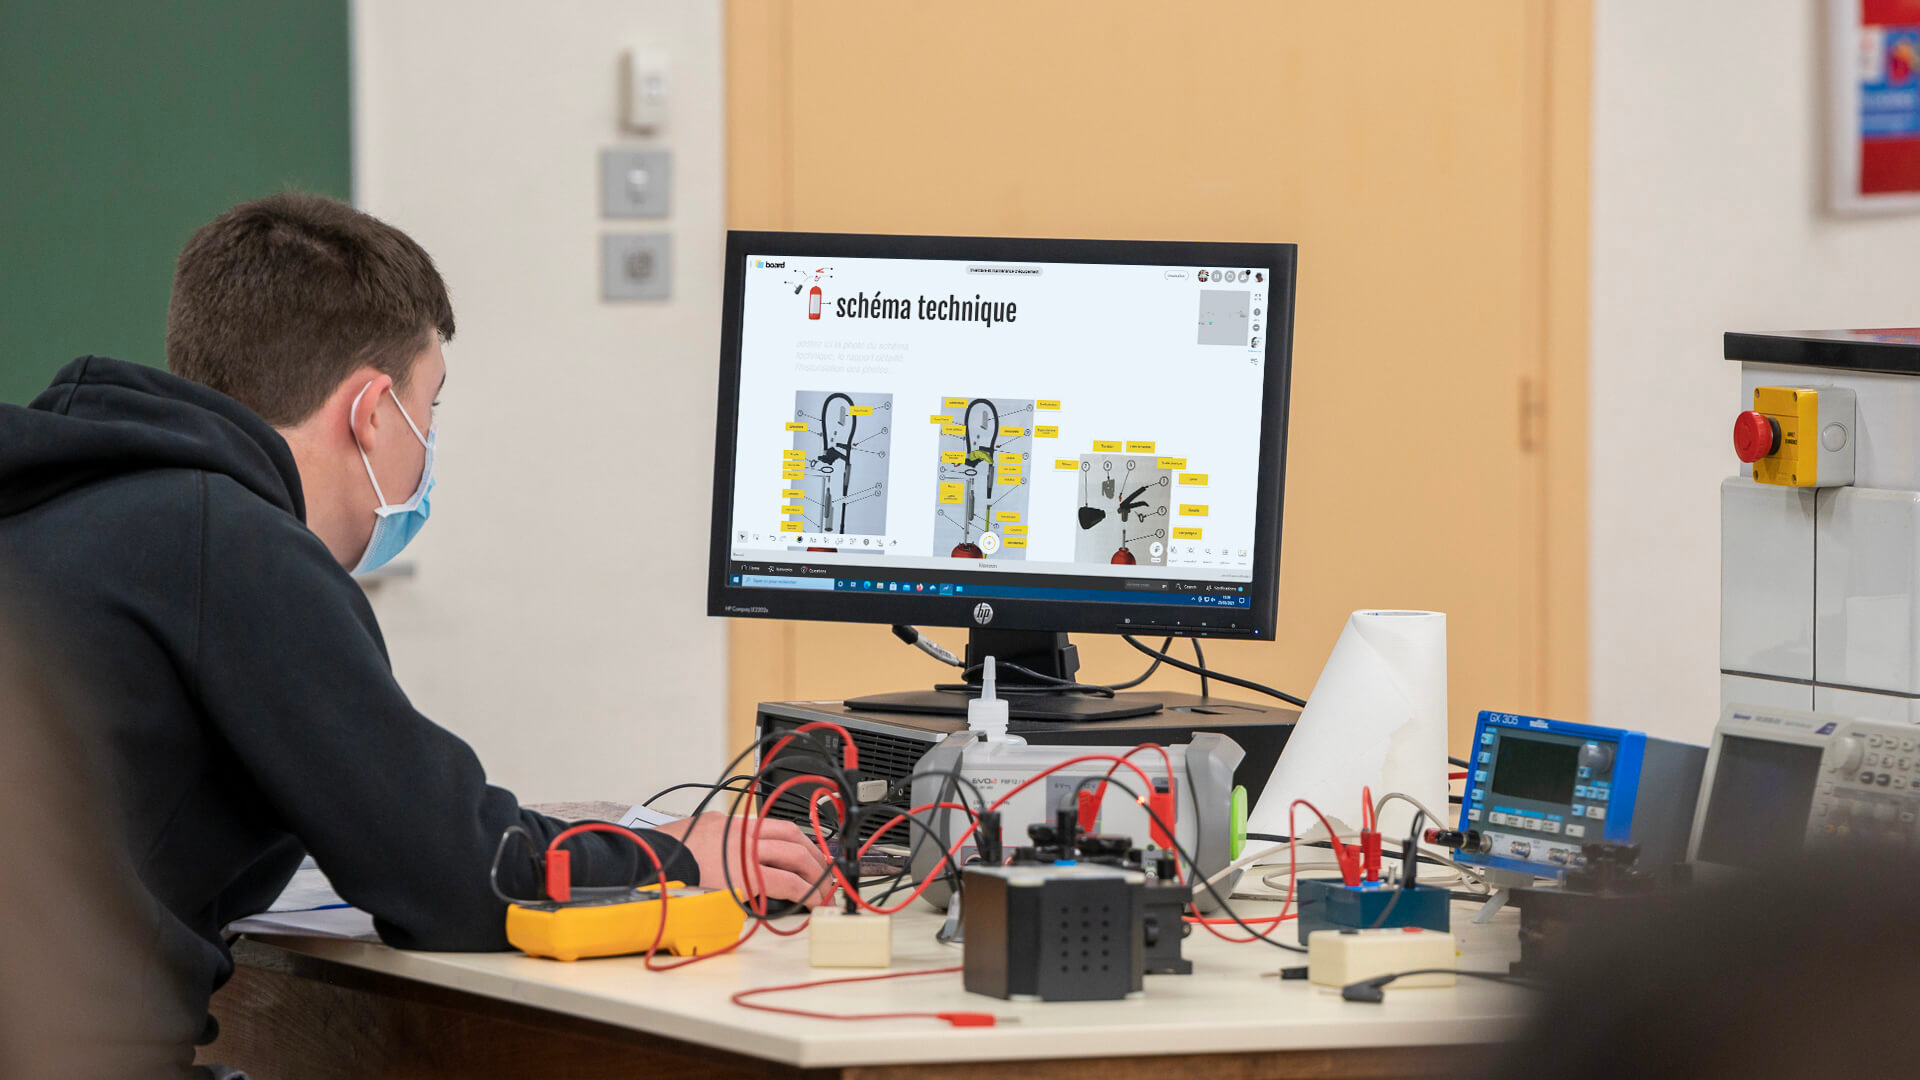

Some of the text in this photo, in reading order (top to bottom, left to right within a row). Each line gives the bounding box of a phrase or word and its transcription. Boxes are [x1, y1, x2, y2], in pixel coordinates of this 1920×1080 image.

[765, 260, 786, 269] board
[836, 290, 1017, 328] schéma technique
[1490, 713, 1501, 723] GX
[1502, 714, 1518, 725] 305
